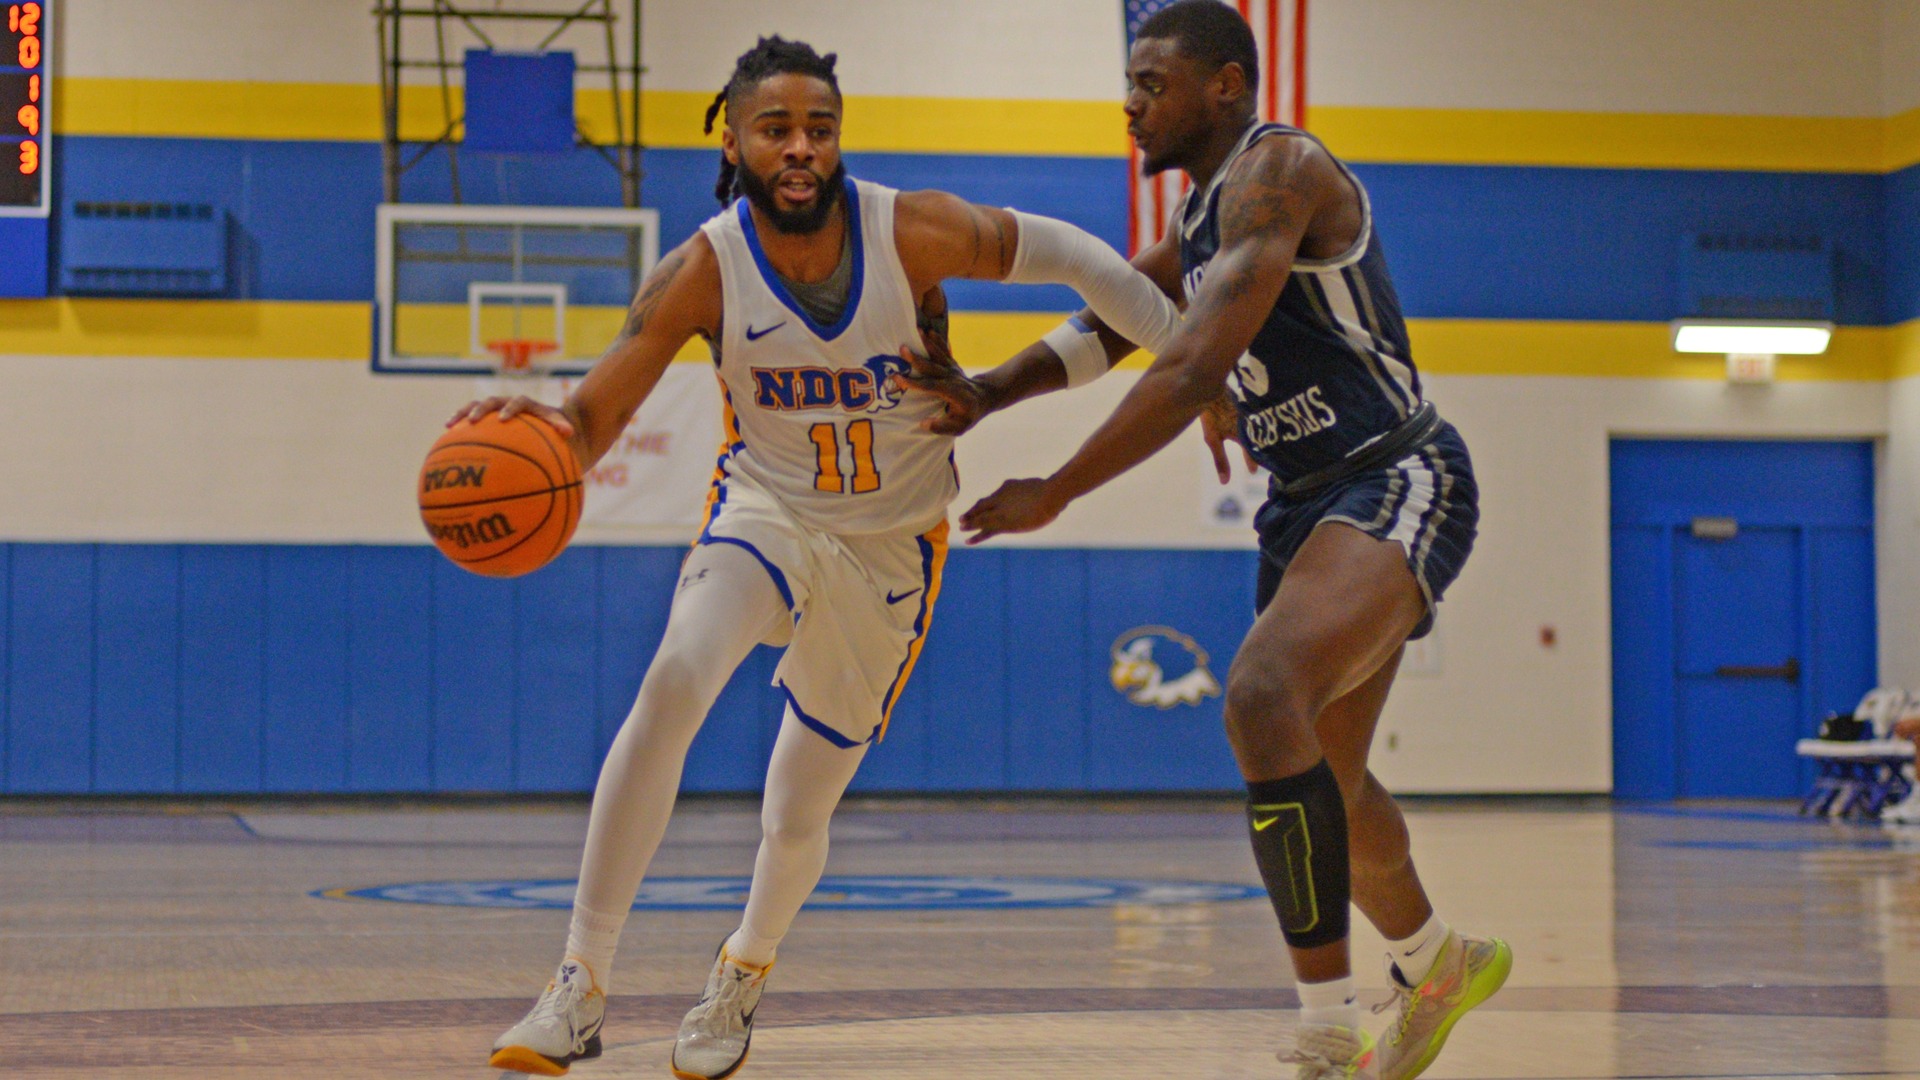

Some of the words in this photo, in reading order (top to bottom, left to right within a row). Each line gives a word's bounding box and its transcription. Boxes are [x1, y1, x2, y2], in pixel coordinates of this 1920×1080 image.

[18, 104, 39, 136] 9
[19, 140, 39, 175] 3
[751, 366, 874, 412] NDC
[808, 418, 881, 494] 11
